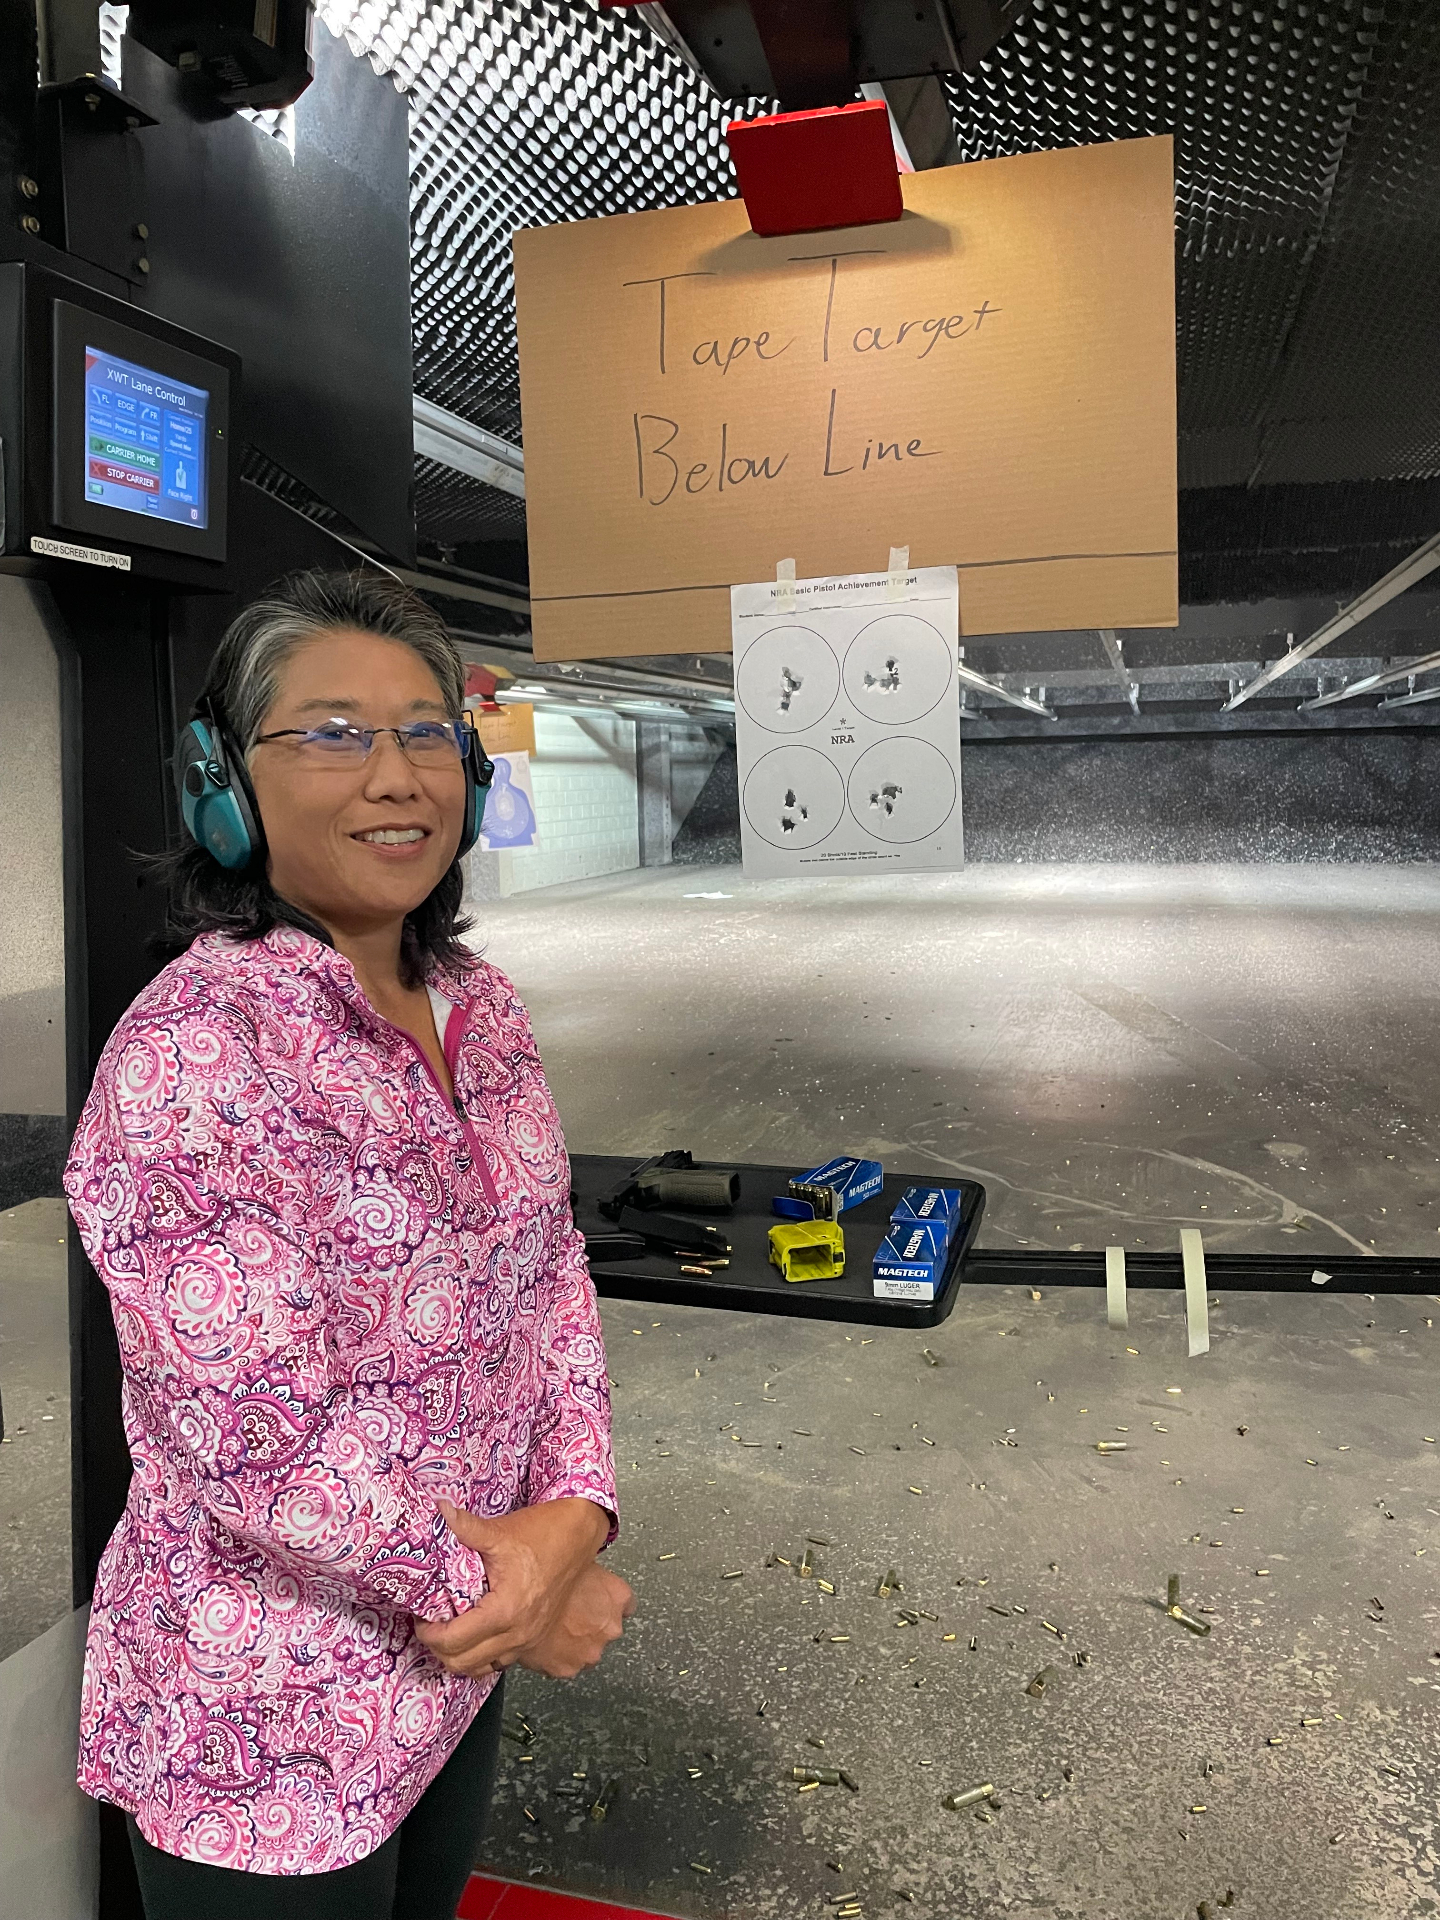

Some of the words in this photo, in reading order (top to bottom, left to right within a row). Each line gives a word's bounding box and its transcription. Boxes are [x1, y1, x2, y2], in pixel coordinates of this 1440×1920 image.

[623, 272, 798, 376] Tape
[787, 250, 1003, 362] Target
[107, 368, 129, 386] XWT
[131, 377, 153, 395] Lane
[155, 386, 186, 407] Control
[101, 394, 110, 404] FL
[117, 399, 135, 412] EDGE
[150, 411, 158, 420] FR
[114, 423, 137, 436] Program
[106, 444, 135, 460] CARRIER
[136, 454, 156, 467] HOME
[633, 413, 789, 506] Below
[823, 388, 944, 477] Line
[107, 467, 125, 479] STOP
[126, 473, 154, 488] CARRIER
[33, 539, 59, 553] TOUCH
[59, 545, 88, 559] SCREEN
[90, 551, 99, 561] TO
[100, 554, 118, 565] TURN
[119, 557, 129, 567] ON
[770, 588, 788, 597] NRA
[790, 586, 811, 595] Basic
[813, 583, 836, 593] Pistol
[837, 579, 889, 590] Achievement
[891, 576, 918, 586] Target
[831, 734, 855, 745] NRA
[813, 1160, 857, 1182] MAGTECH
[848, 1175, 882, 1199] MAGTECH
[917, 1192, 940, 1217] MAGTECH
[902, 1229, 926, 1258] MAGTECH
[877, 1267, 929, 1278] MAGTECH
